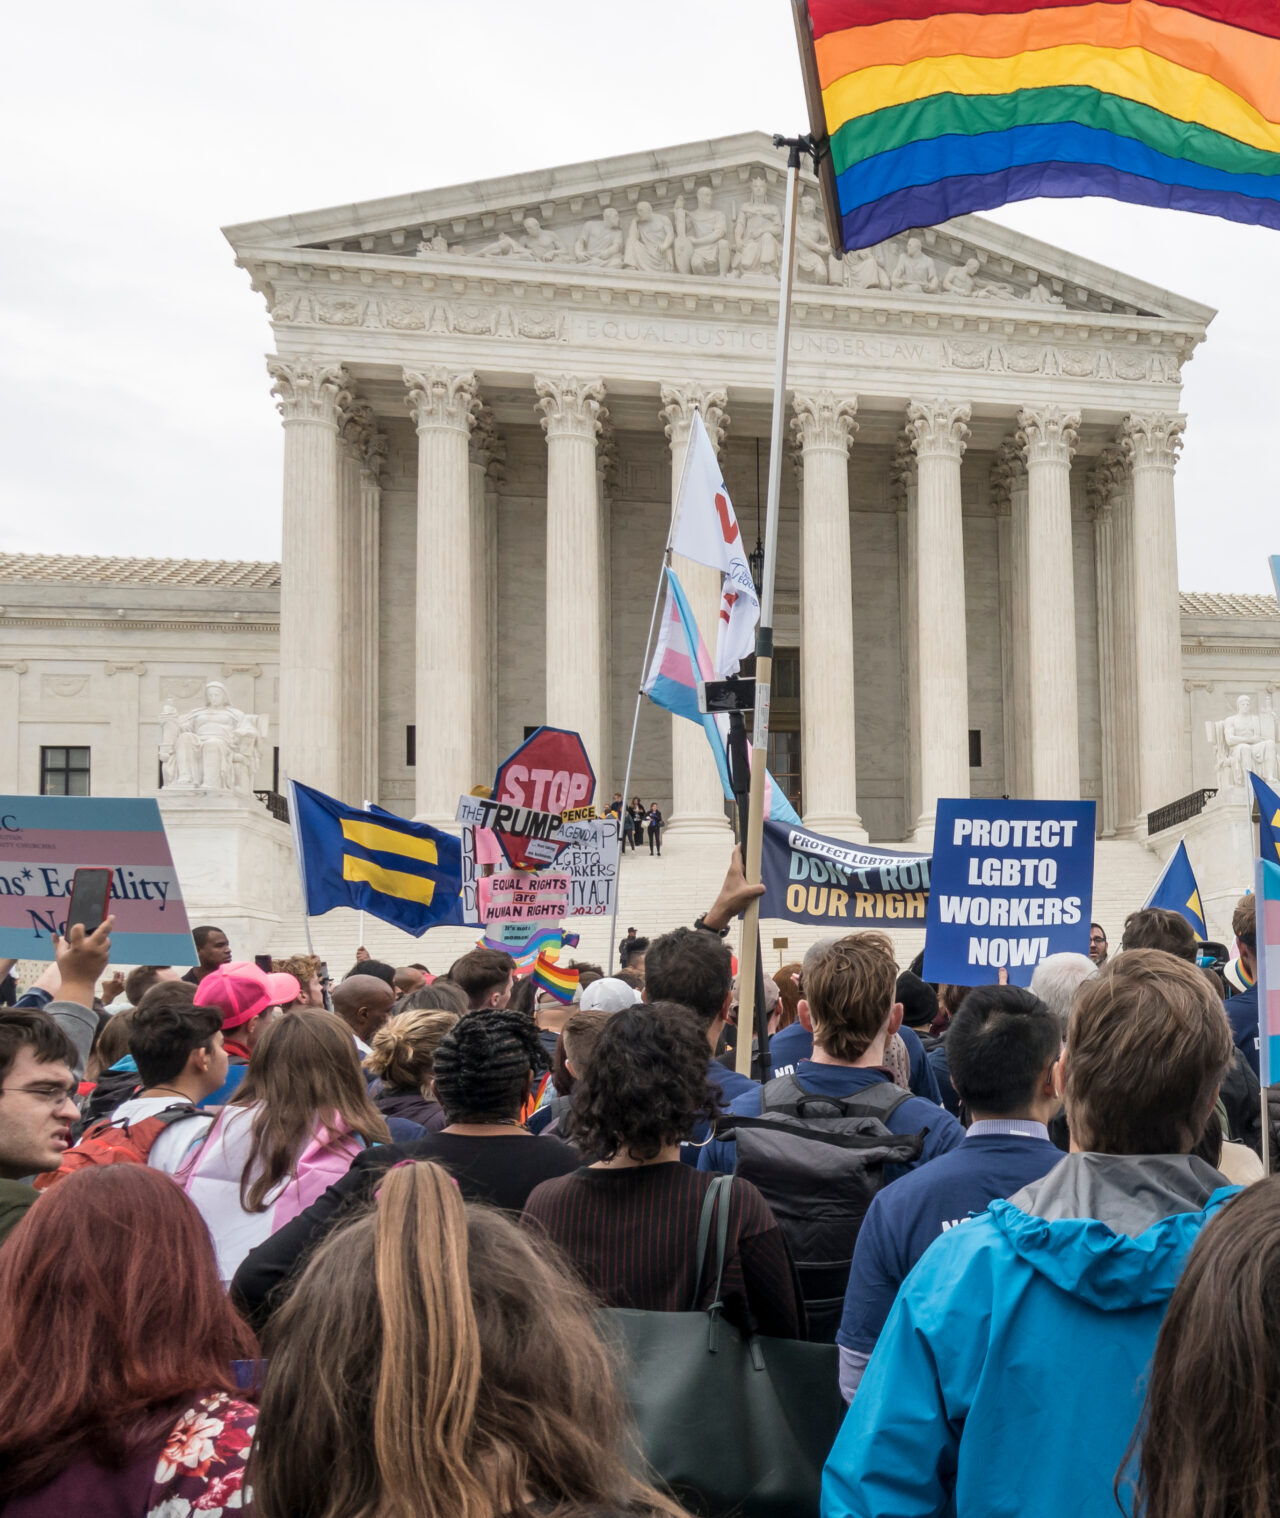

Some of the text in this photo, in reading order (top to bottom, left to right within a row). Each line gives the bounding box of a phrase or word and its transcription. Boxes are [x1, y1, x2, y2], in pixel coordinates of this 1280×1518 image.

[790, 334, 873, 358] UNDER
[880, 342, 925, 360] LAW
[501, 764, 589, 815] STOP
[462, 805, 483, 822] THE
[479, 800, 563, 841] TRUMP
[563, 807, 595, 821] PENCE
[557, 825, 598, 843] AGENDA
[792, 835, 851, 859] PROTECT
[953, 818, 1078, 848] PROTECT
[492, 878, 567, 891] EQUAL RIGHTS
[789, 851, 931, 890] DON'T ROL
[968, 857, 1058, 889] LGBTQ
[39, 867, 170, 912] Eality
[514, 892, 537, 903] are
[588, 879, 613, 906] ACT
[786, 883, 849, 917] OUR
[486, 905, 565, 919] HUMAN RIGHTS
[570, 905, 606, 916] 2020!
[939, 895, 1082, 927] WORKERS
[968, 936, 1049, 968] NOW!
